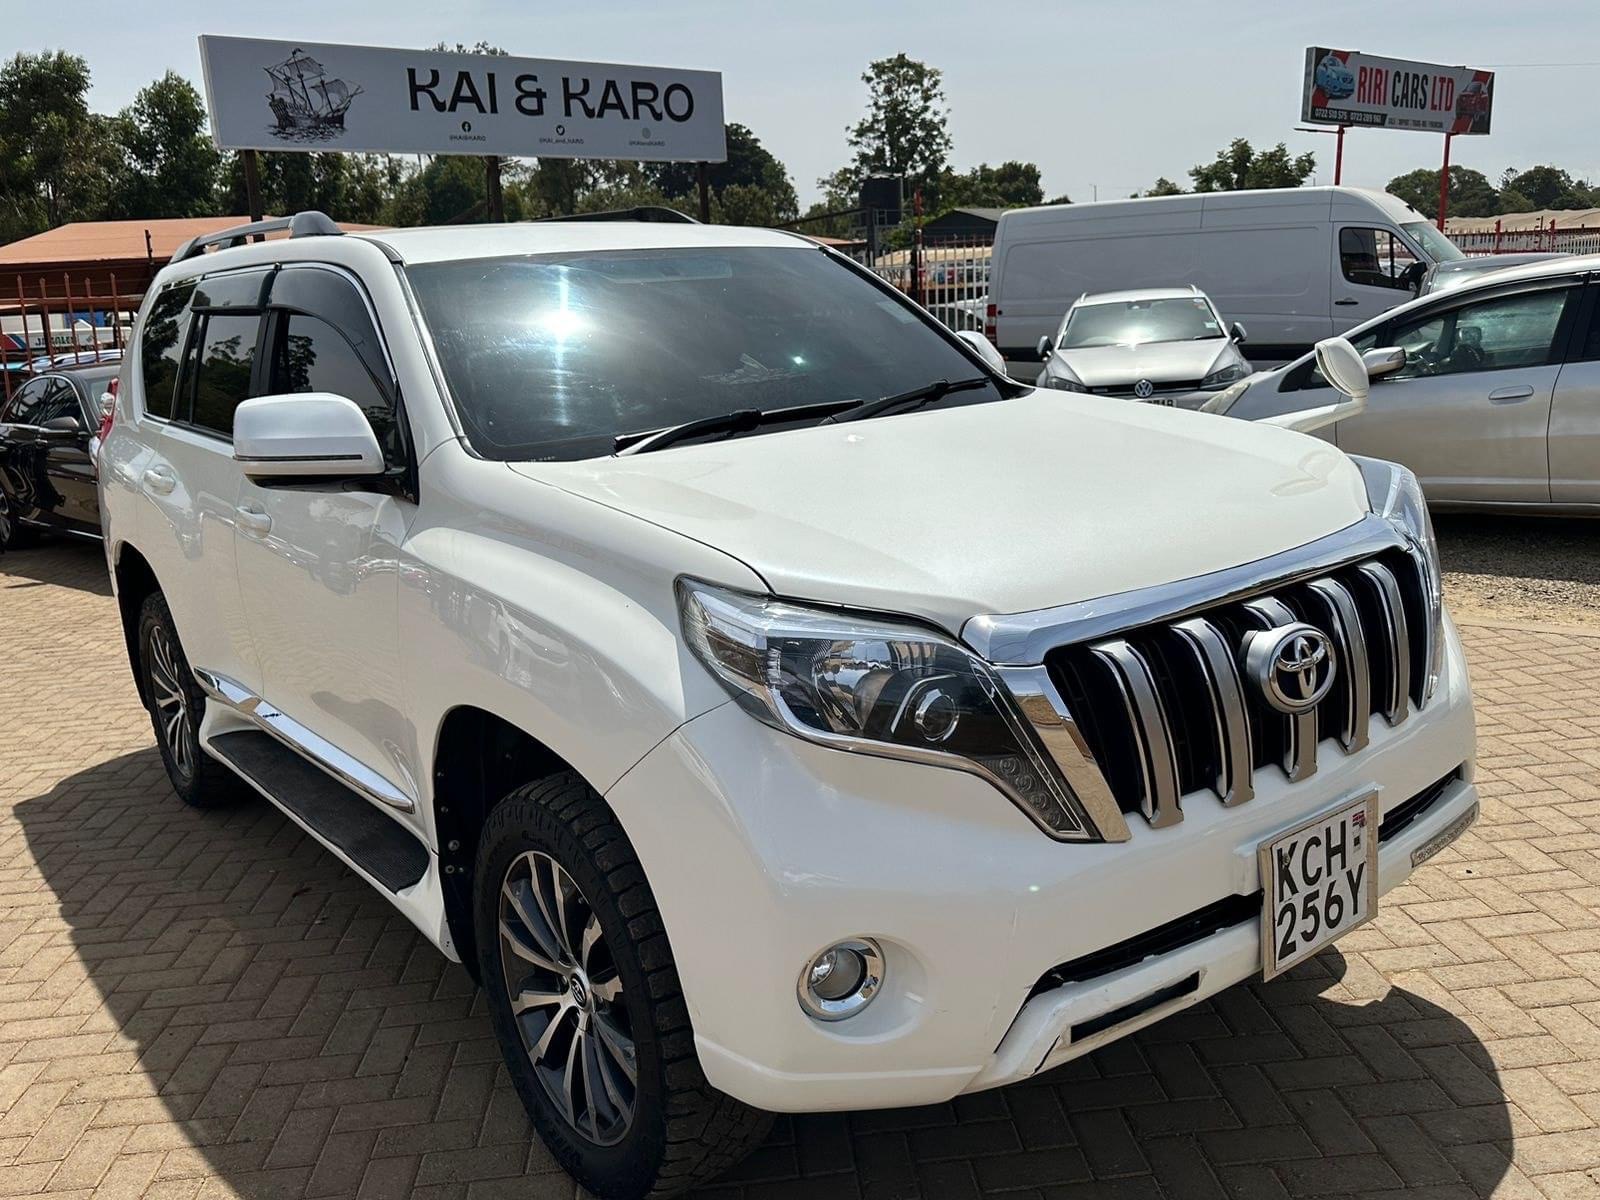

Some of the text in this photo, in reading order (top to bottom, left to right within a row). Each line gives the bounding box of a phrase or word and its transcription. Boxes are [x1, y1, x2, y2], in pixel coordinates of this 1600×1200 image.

[407, 67, 694, 122] KAI & KARO
[1356, 66, 1455, 112] RIRI CARS LTD
[1276, 820, 1347, 903] KCH
[1276, 862, 1364, 961] 256Y
